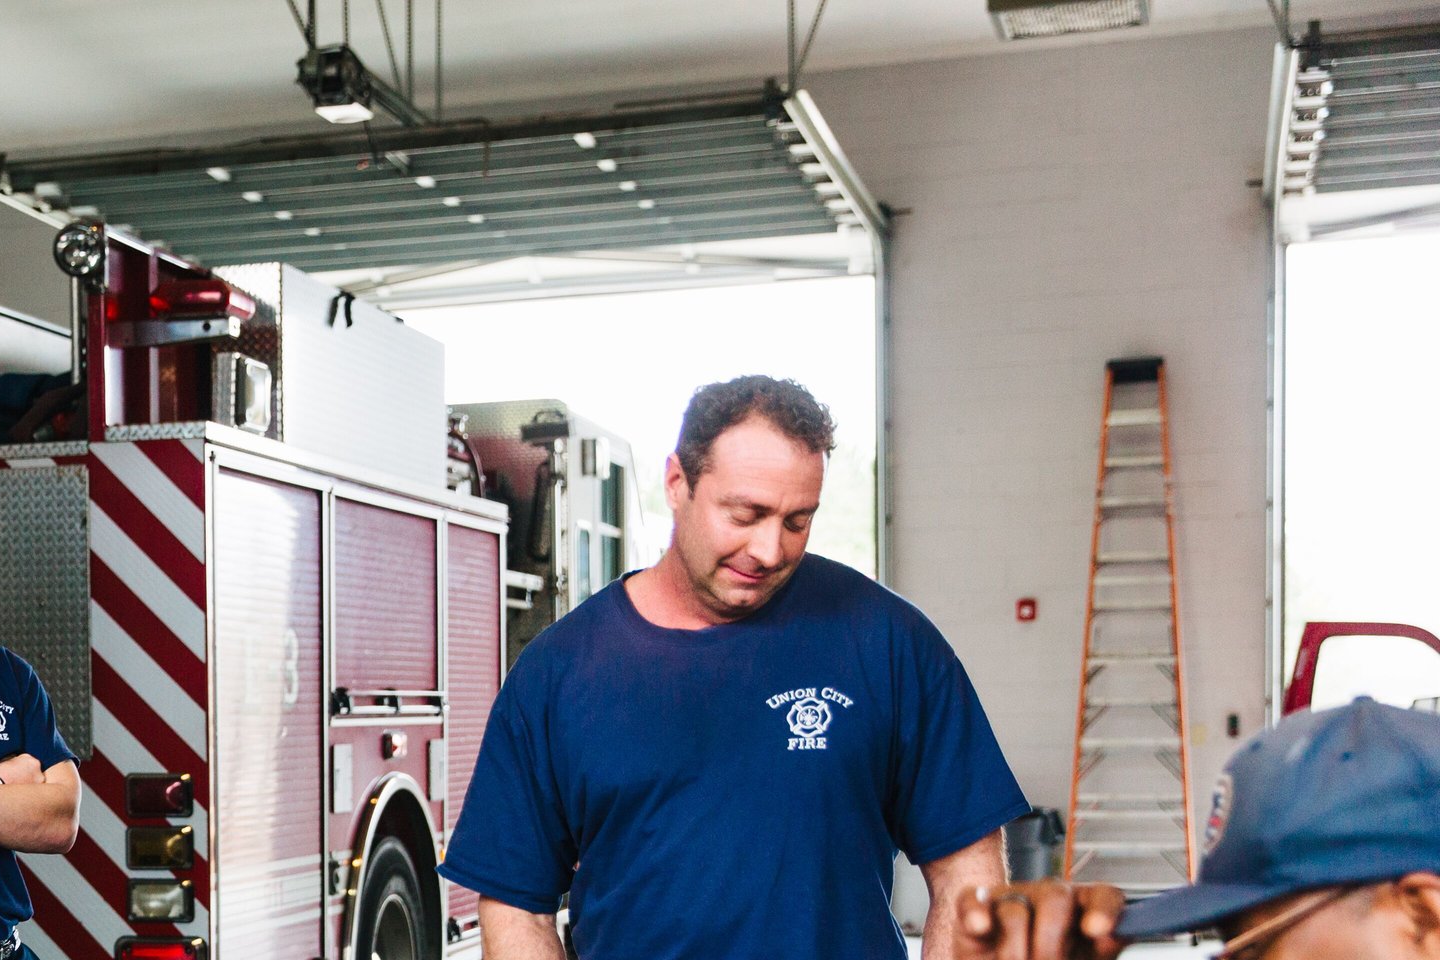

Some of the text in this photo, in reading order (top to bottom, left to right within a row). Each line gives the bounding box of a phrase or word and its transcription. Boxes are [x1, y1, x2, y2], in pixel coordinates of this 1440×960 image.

[765, 687, 854, 709] UNION CITY
[787, 737, 827, 750] FIRE
